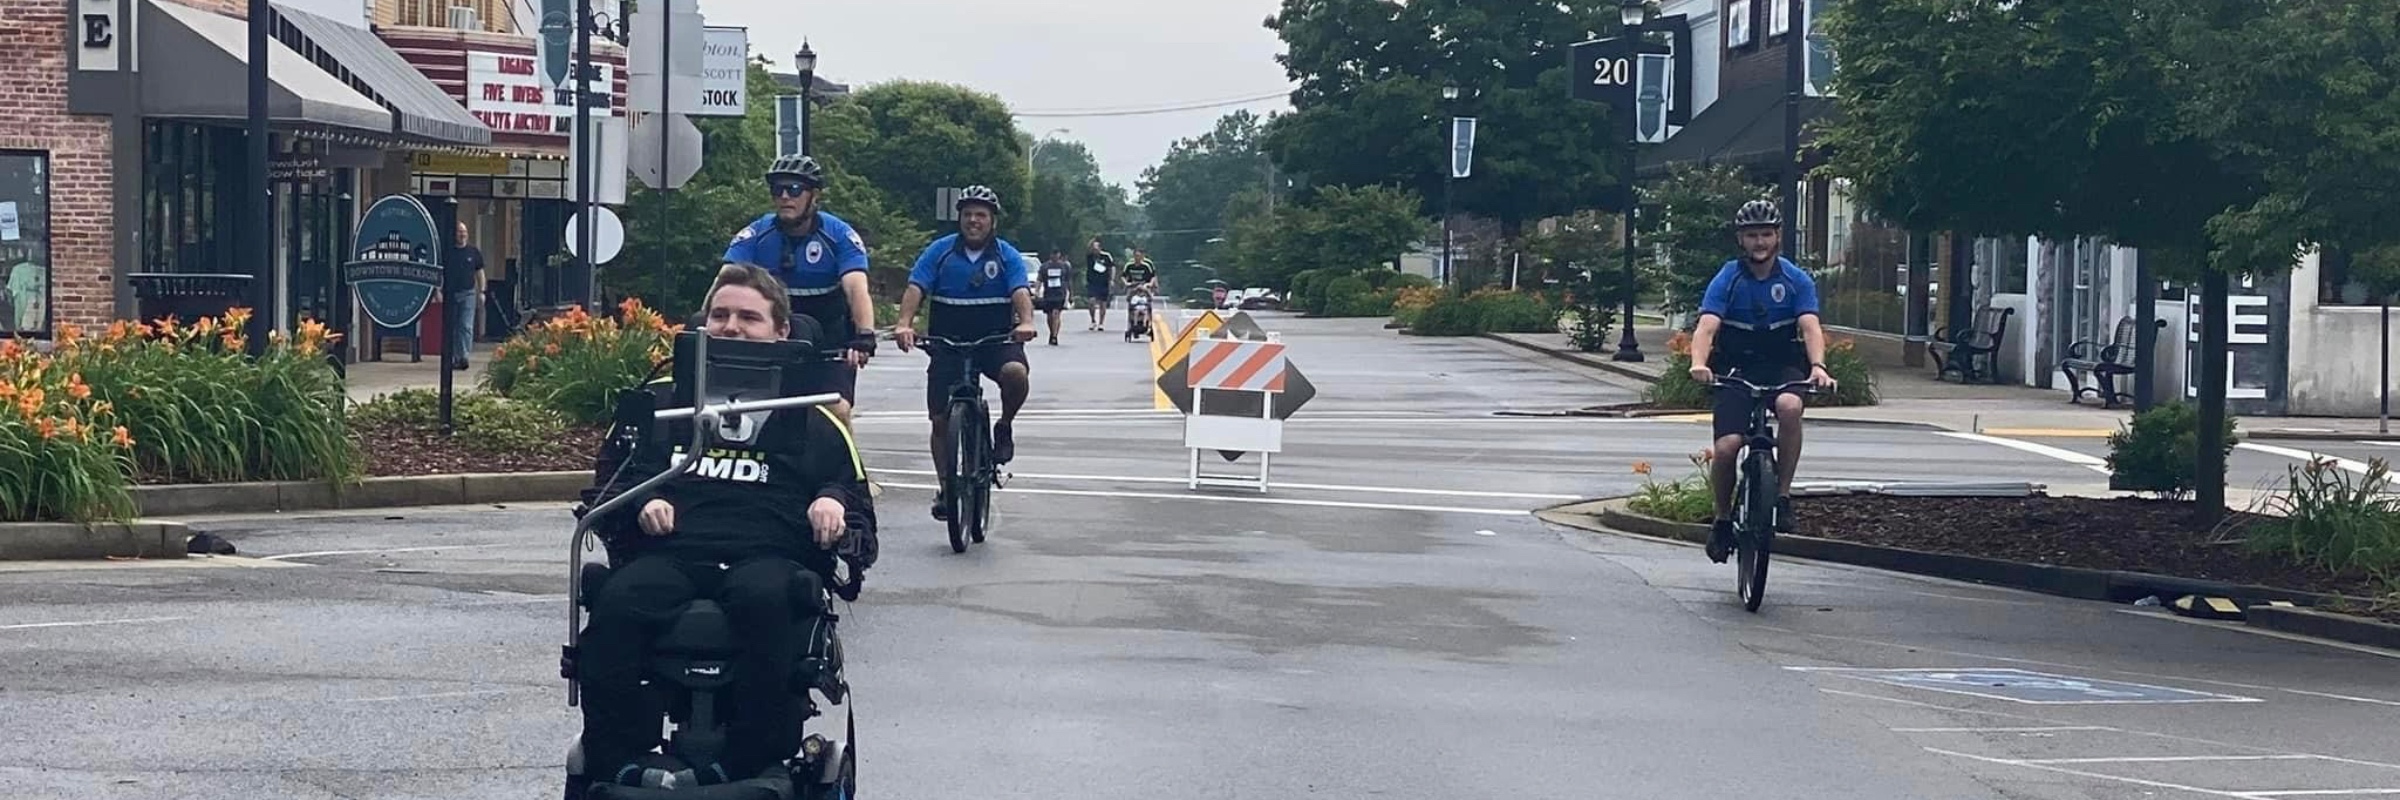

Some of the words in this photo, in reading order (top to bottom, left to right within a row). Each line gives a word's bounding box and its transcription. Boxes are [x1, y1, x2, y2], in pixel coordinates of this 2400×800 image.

[703, 69, 742, 80] SCOTT
[1593, 57, 1629, 86] 20
[482, 83, 506, 101] FIVE
[350, 266, 400, 278] DOWNTOWN
[402, 266, 439, 281] DICKSON
